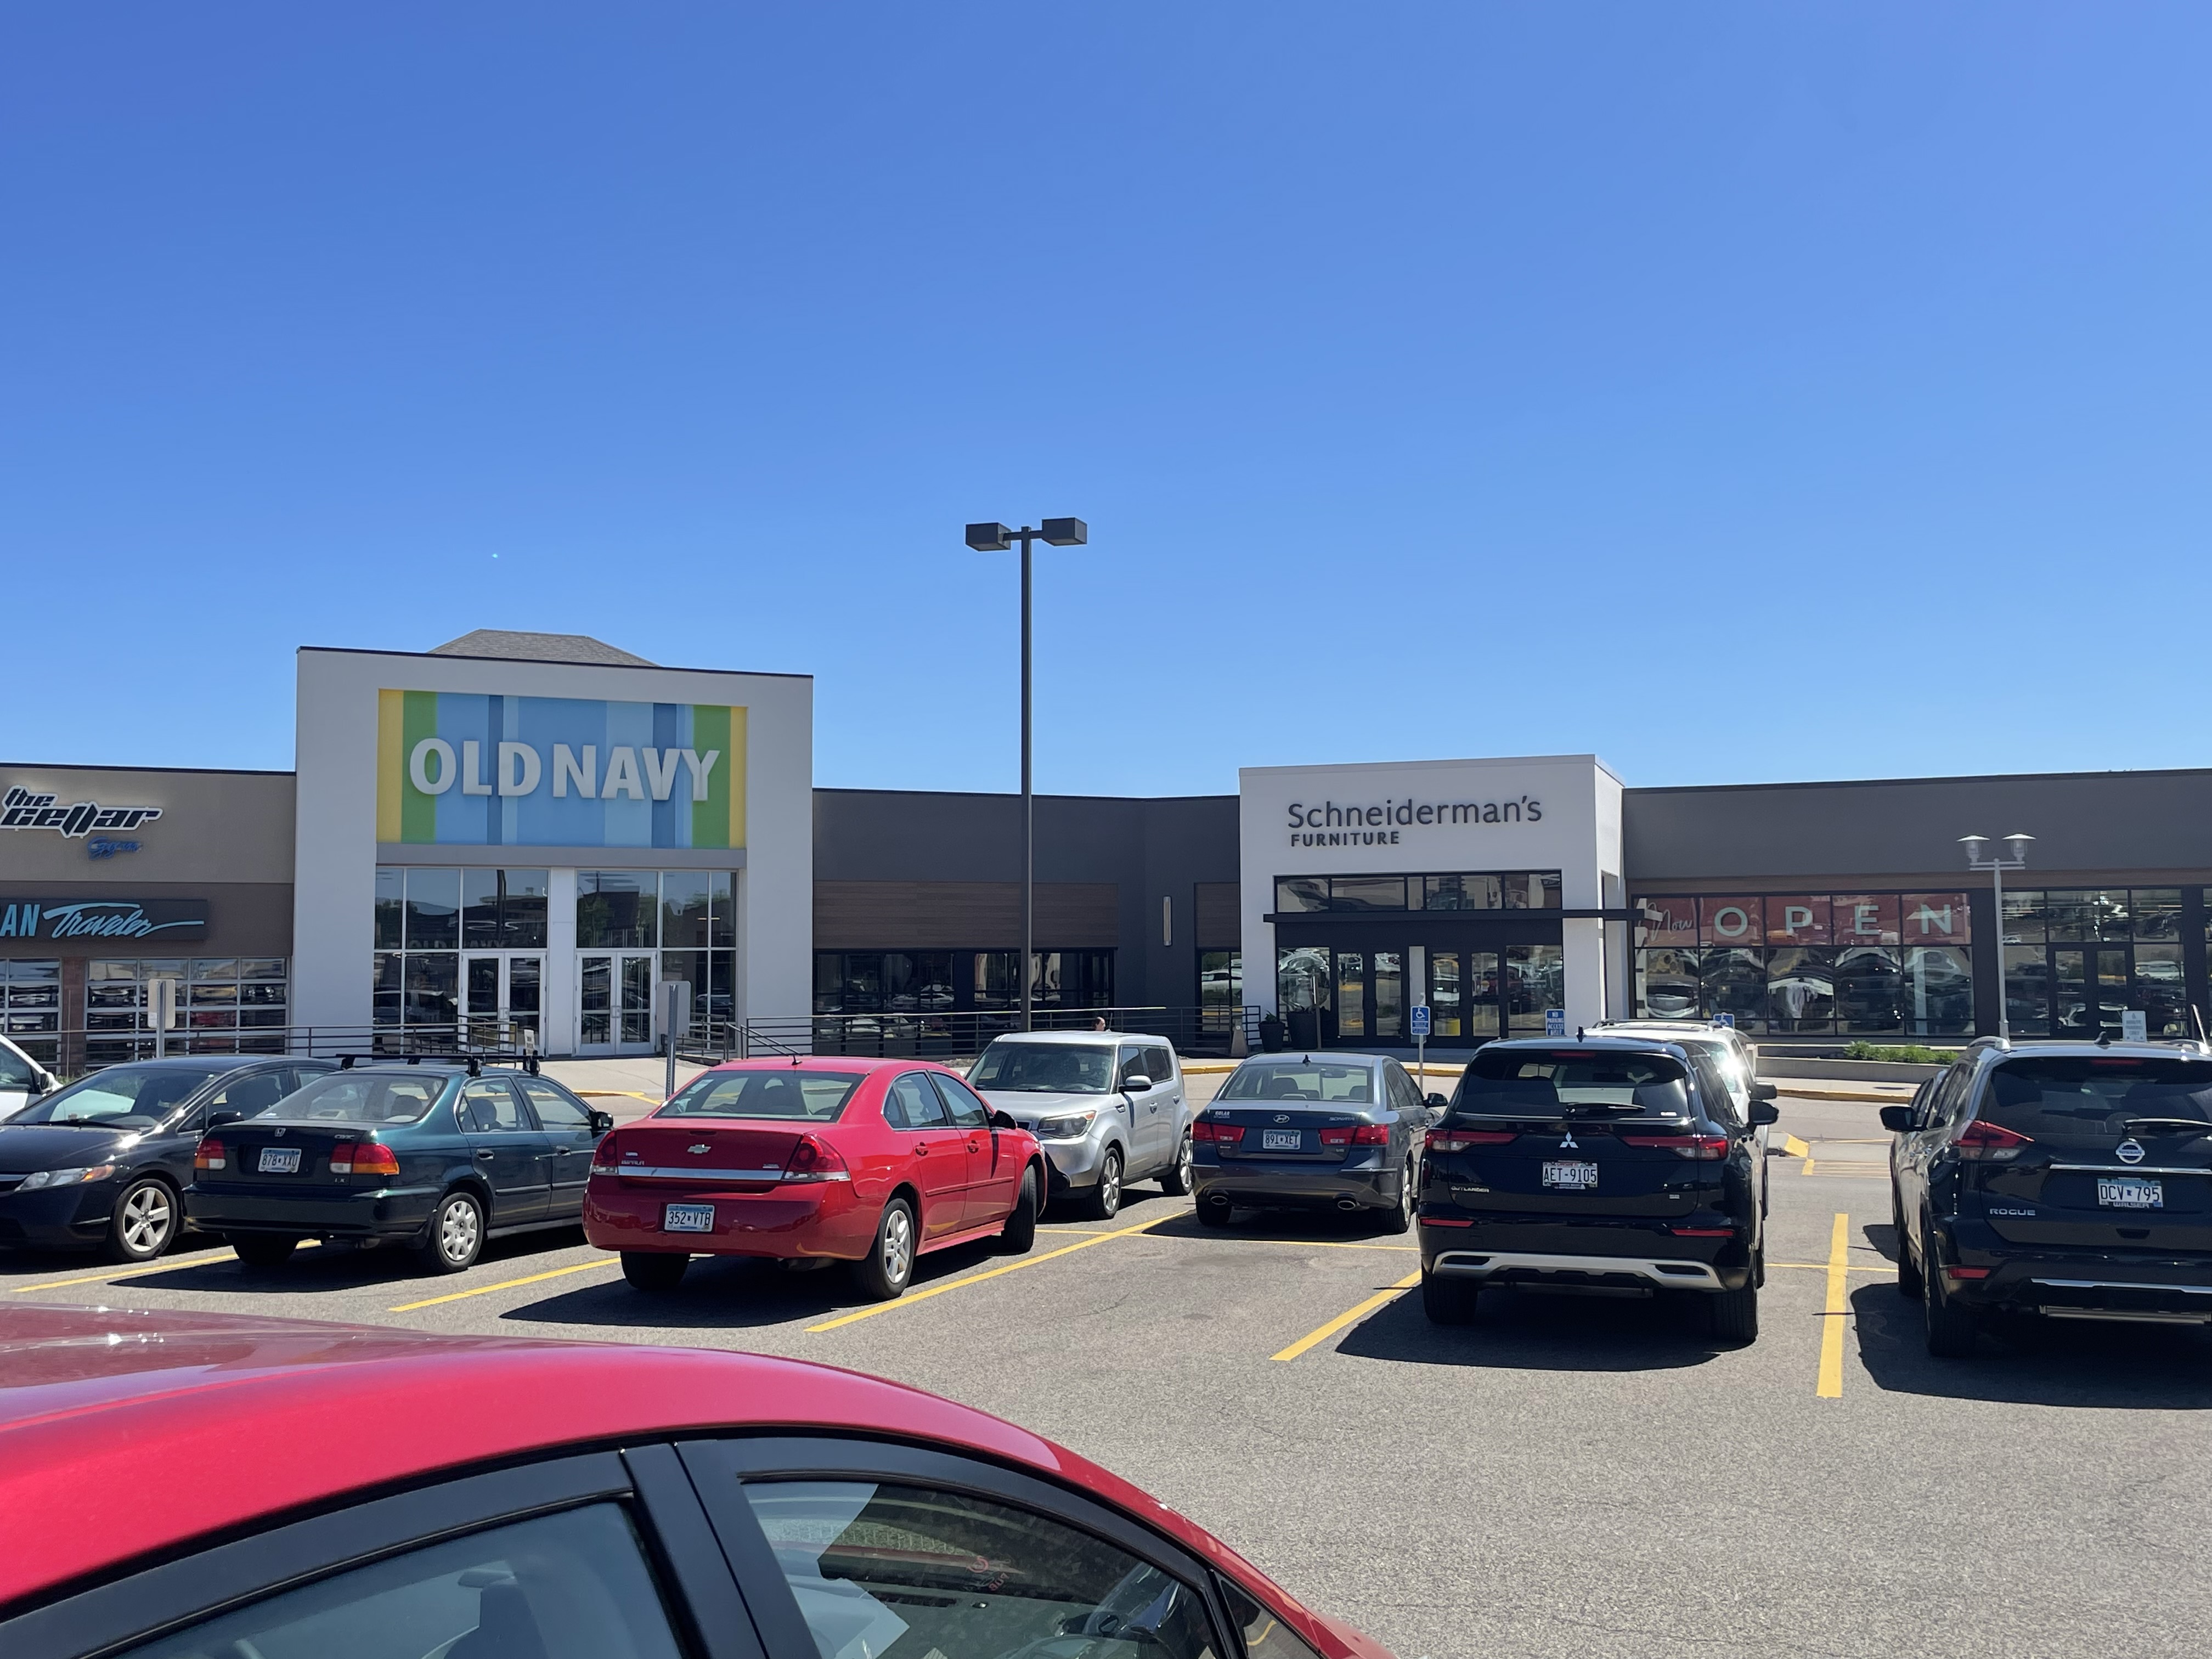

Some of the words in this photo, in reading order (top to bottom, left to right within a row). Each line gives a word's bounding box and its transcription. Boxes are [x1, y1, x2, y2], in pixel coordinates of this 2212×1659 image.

[409, 738, 541, 797] OLD
[552, 743, 720, 802] NAVY
[3, 786, 57, 806] the
[0, 803, 162, 837] cellar
[1288, 795, 1543, 828] Schneiderman's
[1290, 831, 1400, 847] FURNITURE
[42, 902, 204, 939] Traveler
[1714, 904, 1953, 937] OPEN
[1265, 1135, 1279, 1144] 891
[262, 1154, 278, 1166] 878
[1543, 1167, 1597, 1183] AET-9105
[2135, 1186, 2160, 1202] 795
[668, 1211, 686, 1224] 352
